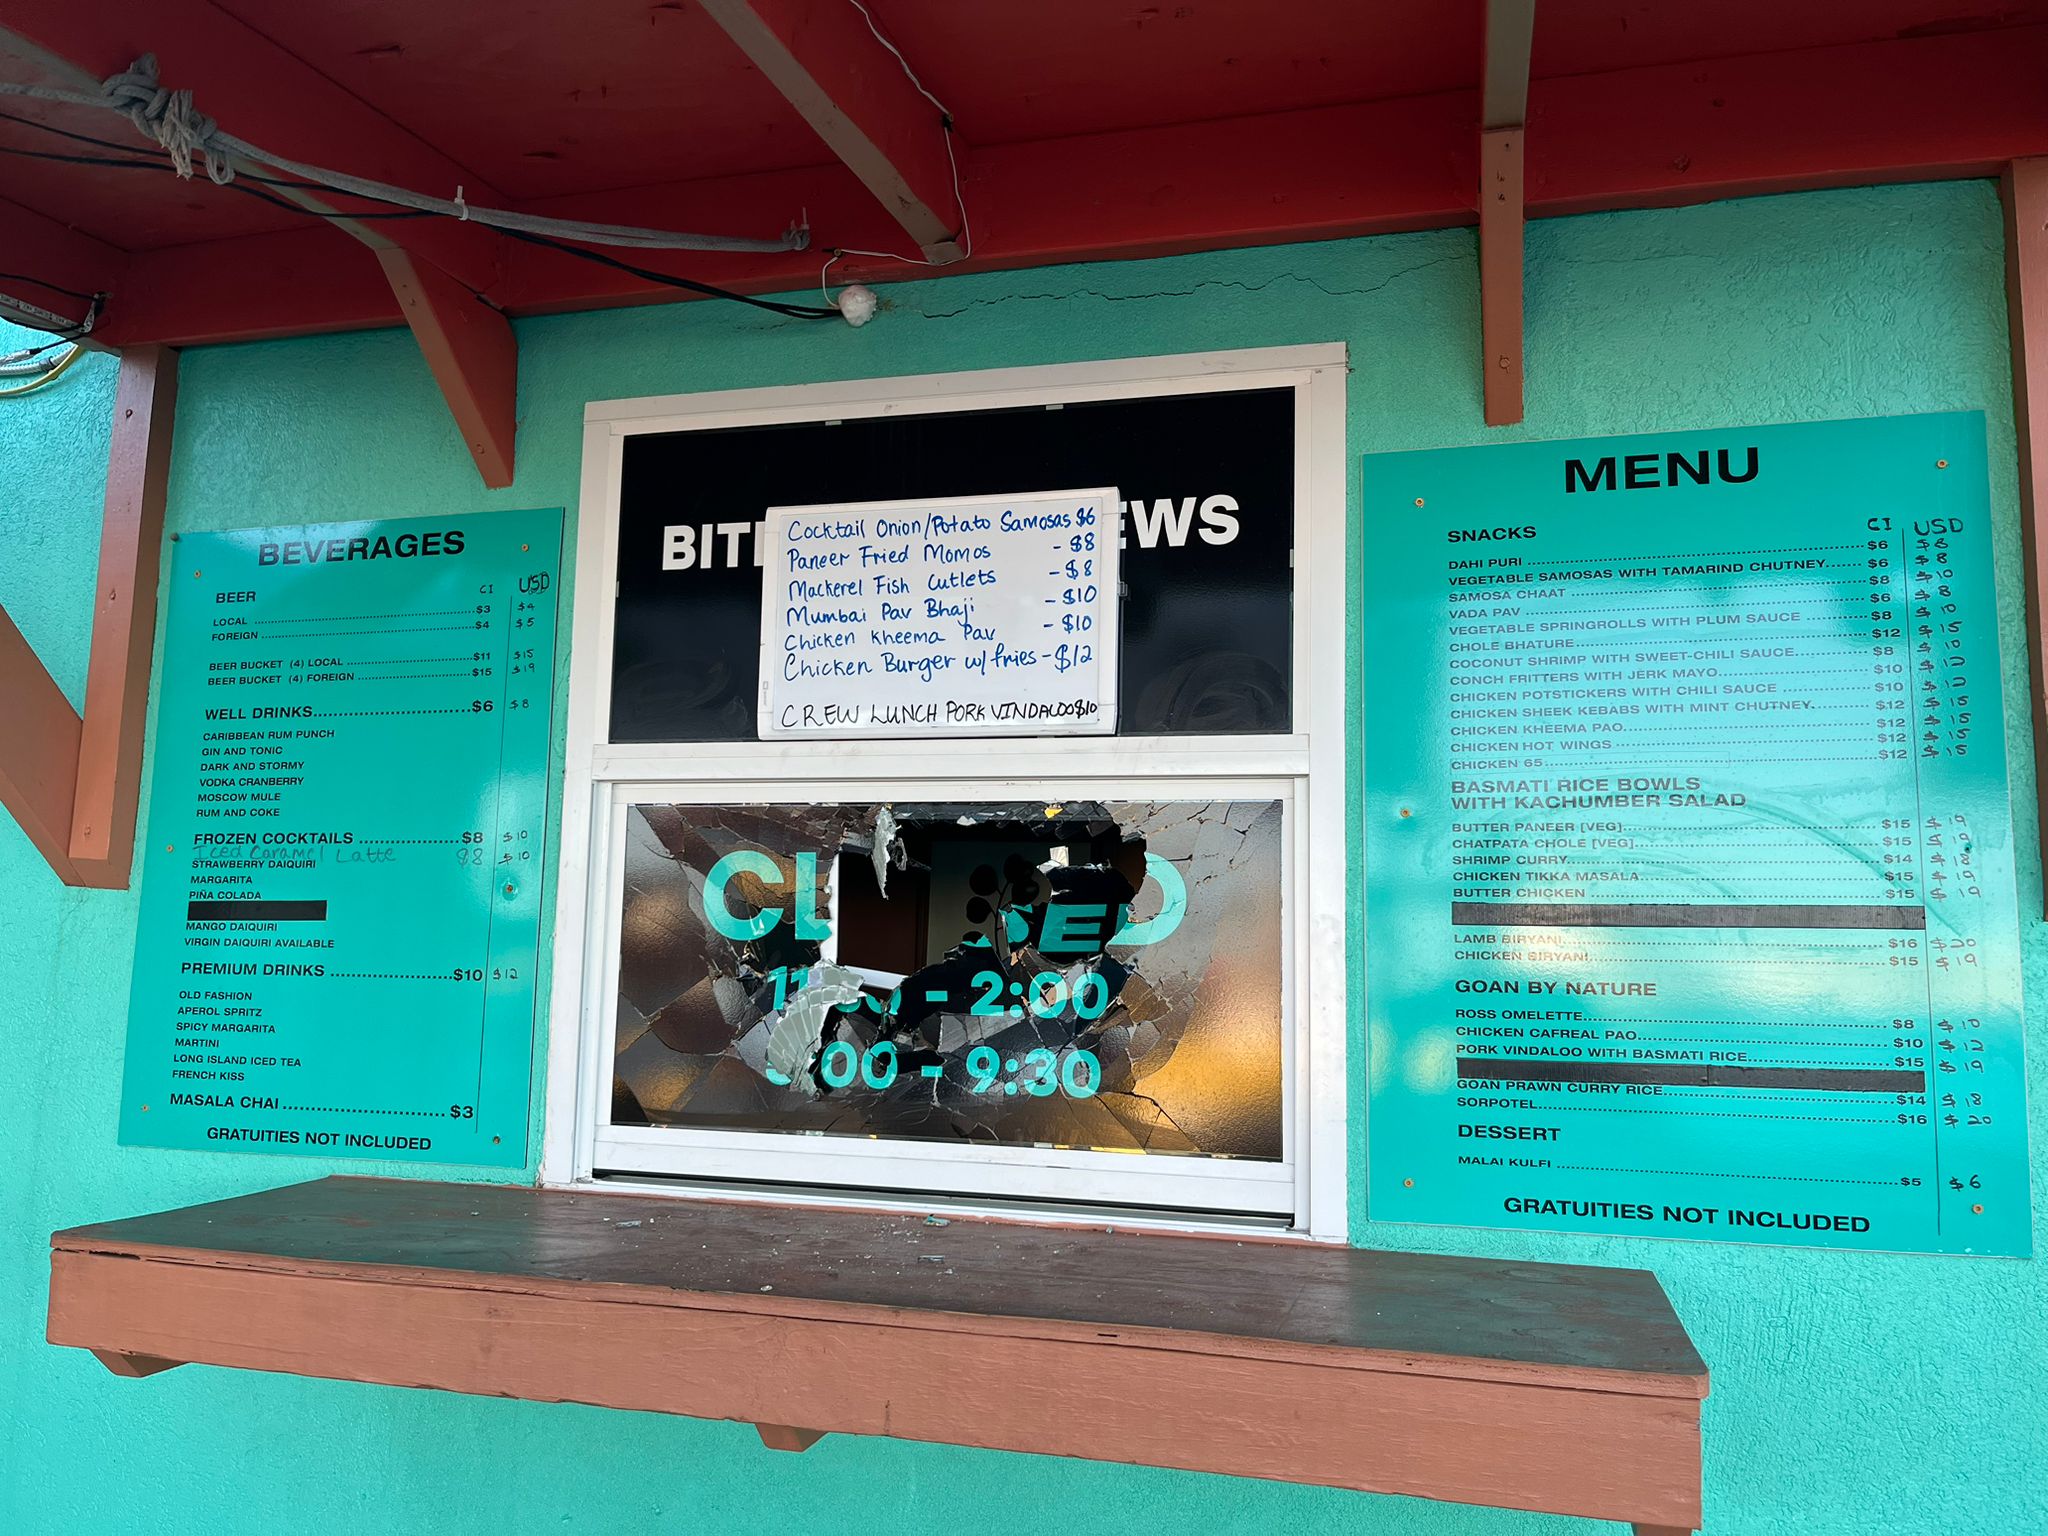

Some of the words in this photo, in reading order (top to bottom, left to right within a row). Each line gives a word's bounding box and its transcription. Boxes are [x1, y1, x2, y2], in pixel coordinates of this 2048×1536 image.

[1565, 447, 1759, 493] MENU
[788, 519, 865, 541] Cocktail
[1001, 510, 1071, 532] Samosas
[1076, 507, 1095, 526] $6
[1914, 518, 1963, 535] USD
[1448, 526, 1537, 543] SNACKS
[258, 531, 465, 566] BEVERAGES
[787, 548, 849, 572] Paneer
[859, 544, 909, 568] Fried
[924, 544, 991, 564] Momos
[1070, 532, 1095, 552] $8
[1448, 559, 1484, 570] DAHI
[1488, 557, 1522, 568] PURI
[1868, 541, 1888, 550] $6
[1449, 573, 1533, 586] VEGETABLE
[1539, 569, 1613, 581] SAMOSAS
[1619, 568, 1657, 577] WITH
[1662, 563, 1744, 576] TAMARIND
[1749, 559, 1826, 571] CHUTNEY
[1868, 559, 1888, 568] $6
[518, 573, 550, 593] USD
[789, 579, 862, 602] Mackerel
[873, 575, 910, 595] Fish
[216, 591, 256, 603] BEER
[787, 606, 866, 626] Mumbai
[882, 602, 912, 620] Pav
[924, 597, 974, 627] Bhaji
[1063, 585, 1097, 604] $10
[213, 617, 247, 627] LOCAL
[476, 604, 491, 615] $3
[211, 631, 258, 641] FOREIGN
[475, 620, 489, 630] $4
[785, 631, 855, 651] Chicken
[963, 624, 995, 641] Pav
[1062, 614, 1092, 633] $10
[209, 661, 238, 671] BEER
[241, 660, 283, 670] BUCKET
[290, 659, 304, 669] (4)
[308, 657, 343, 667] LOCAL
[473, 652, 491, 662] $11
[784, 653, 872, 681] Chicken
[881, 652, 956, 682] Burger
[1450, 656, 1522, 670] COCONUT
[1528, 654, 1586, 666] SHRIMP
[1592, 653, 1630, 664] WITH
[1635, 649, 1735, 663] SWEET-CHILI
[1740, 646, 1795, 659] SAUCE
[1873, 647, 1893, 656] $8
[205, 708, 247, 721] WELL
[252, 706, 313, 719] DRINKS
[471, 700, 493, 714] $6
[782, 704, 860, 727] CREW
[871, 703, 937, 724] LUNCH
[946, 700, 985, 723] PORK
[1450, 709, 1518, 719] CHICKEN
[1522, 706, 1572, 717] SHEEK
[1577, 704, 1639, 715] KEBABS
[1645, 703, 1684, 713] WITH
[1690, 702, 1729, 712] MINT
[203, 731, 265, 741] CARIBBEAN
[268, 730, 292, 740] RUM
[296, 729, 335, 739] PUNCH
[200, 762, 230, 771] DARK
[232, 761, 256, 771] AND
[259, 761, 305, 771] STORMY
[200, 778, 236, 787] VODKA
[239, 776, 304, 787] CRANBERRY
[1452, 779, 1550, 793] BASMATI
[1558, 778, 1608, 792] RICE
[1617, 777, 1701, 791] BOWLS
[1452, 796, 1507, 810] WITH
[1514, 795, 1661, 809] KACHUMBER
[1669, 793, 1745, 807] SALAD
[194, 833, 257, 846] FROZEN
[262, 832, 354, 845] COCKTAILS
[462, 831, 483, 845] $8
[192, 860, 265, 869] STRAWBERRY
[268, 860, 316, 869] DAIQUIRI
[1452, 855, 1511, 865] SHRIMP
[1516, 855, 1568, 865] CURRY
[190, 876, 253, 884] MARGARITA
[1453, 871, 1520, 882] CHICKEN
[1526, 871, 1571, 881] TIKKA
[1576, 871, 1639, 881] MASALA
[217, 891, 262, 900] COLADA
[186, 922, 228, 931] MANGO
[231, 922, 278, 932] DAIQUIRI
[184, 938, 221, 947] VIRGIN
[224, 939, 272, 948] DAIQUIRI
[275, 939, 334, 948] AVAILABLE
[181, 963, 258, 975] PREMIUM
[263, 964, 325, 977] DRINKS
[453, 969, 483, 982] $10
[970, 971, 1108, 1019] 2:00
[1455, 980, 1520, 994] GOAN
[1527, 981, 1557, 994] BY
[1566, 982, 1657, 996] NATURE
[1456, 1009, 1497, 1020] ROSS
[1501, 1010, 1583, 1021] OMELETTE
[175, 1038, 219, 1048] MARTINI
[1456, 1027, 1525, 1037] CHICKEN
[1529, 1028, 1600, 1040] CAFREAL
[1605, 1031, 1637, 1040] PAO
[173, 1054, 204, 1064] LONG
[207, 1055, 247, 1065] ISLAND
[250, 1056, 278, 1066] ICED
[281, 1058, 302, 1067] TEA
[1456, 1045, 1499, 1055] PORK
[1503, 1046, 1582, 1058] VINDALOO
[1587, 1048, 1629, 1058] WITH
[1632, 1049, 1704, 1061] BASMATI
[1709, 1052, 1747, 1062] RICE
[1895, 1057, 1924, 1068] $15
[966, 1046, 1101, 1099] 9:30
[1457, 1080, 1501, 1090] GOAN
[1506, 1081, 1563, 1093] PRAWN
[1567, 1083, 1622, 1095] CURRY
[1626, 1085, 1664, 1095] RICE
[170, 1094, 235, 1107] MASALA
[240, 1096, 279, 1109] CHAI
[450, 1105, 473, 1119] $3
[1457, 1098, 1539, 1109] SORPOTEL
[1898, 1114, 1927, 1125] $16
[207, 1127, 300, 1144] GRATUITIES
[305, 1132, 341, 1145] NOT
[345, 1133, 432, 1150] INCLUDED
[1458, 1125, 1560, 1141] DESSERT
[1458, 1156, 1504, 1166] MALAI
[1509, 1158, 1552, 1168] KULFI
[1901, 1177, 1921, 1186] $5
[1504, 1197, 1654, 1220] GRATUITIES
[1663, 1206, 1719, 1225] NOT
[1727, 1209, 1870, 1233] INCLUDED
